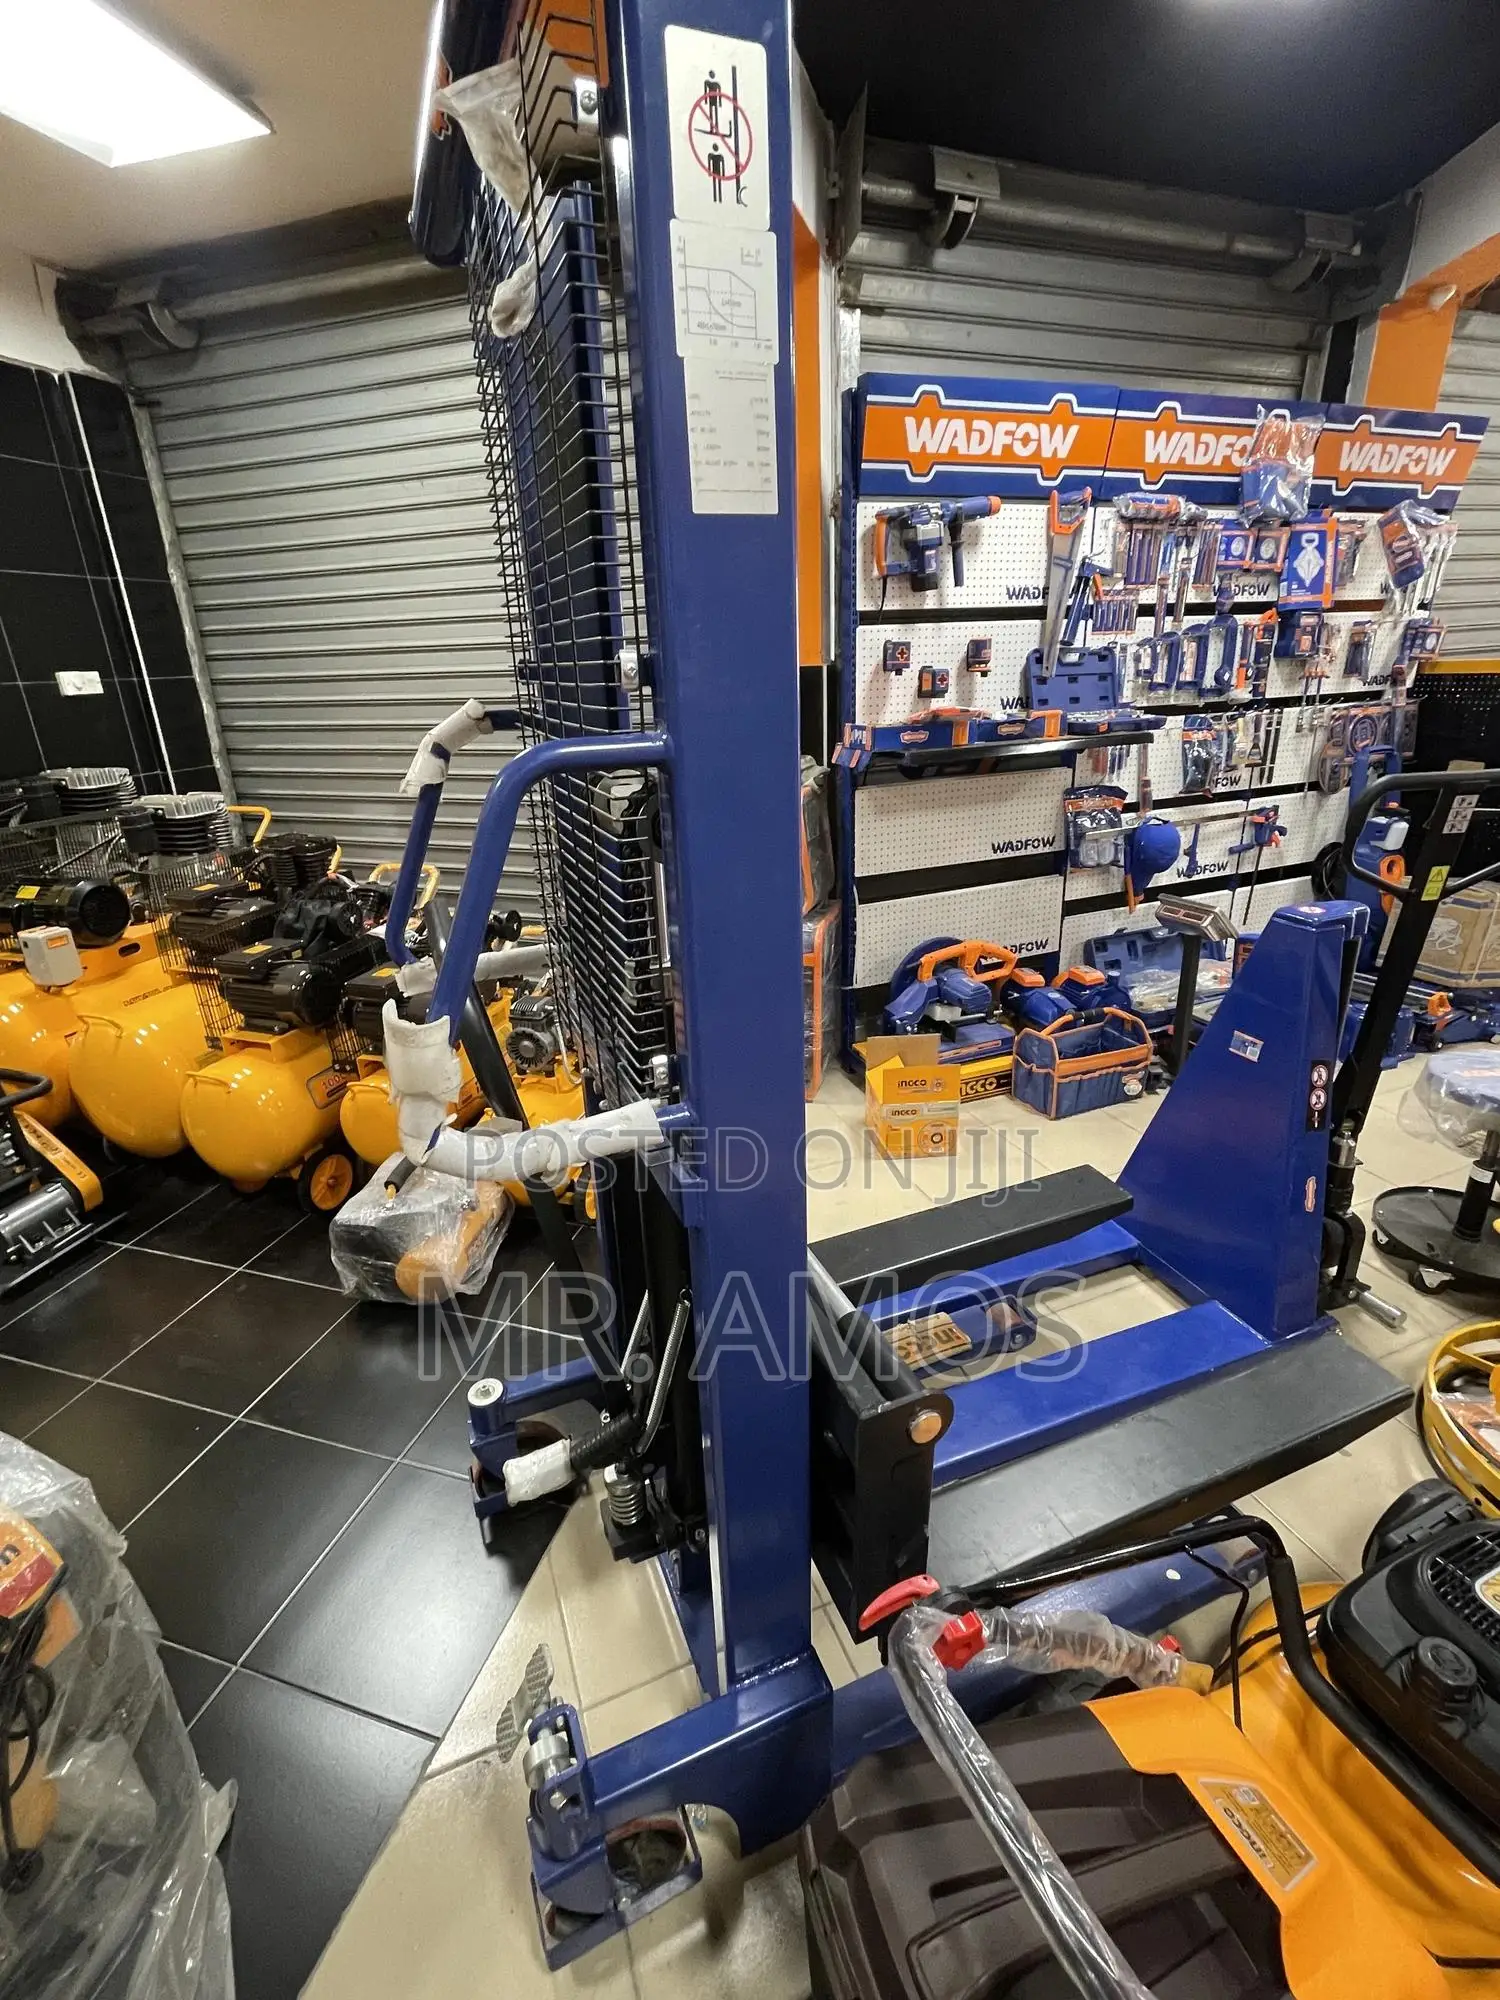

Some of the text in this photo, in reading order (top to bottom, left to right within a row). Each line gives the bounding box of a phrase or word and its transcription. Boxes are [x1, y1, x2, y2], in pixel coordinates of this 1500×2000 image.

[904, 416, 1080, 459] WADFOW
[1144, 429, 1251, 468] WADFO
[1338, 440, 1456, 477] WADFOW
[992, 835, 1056, 855] WADFOW
